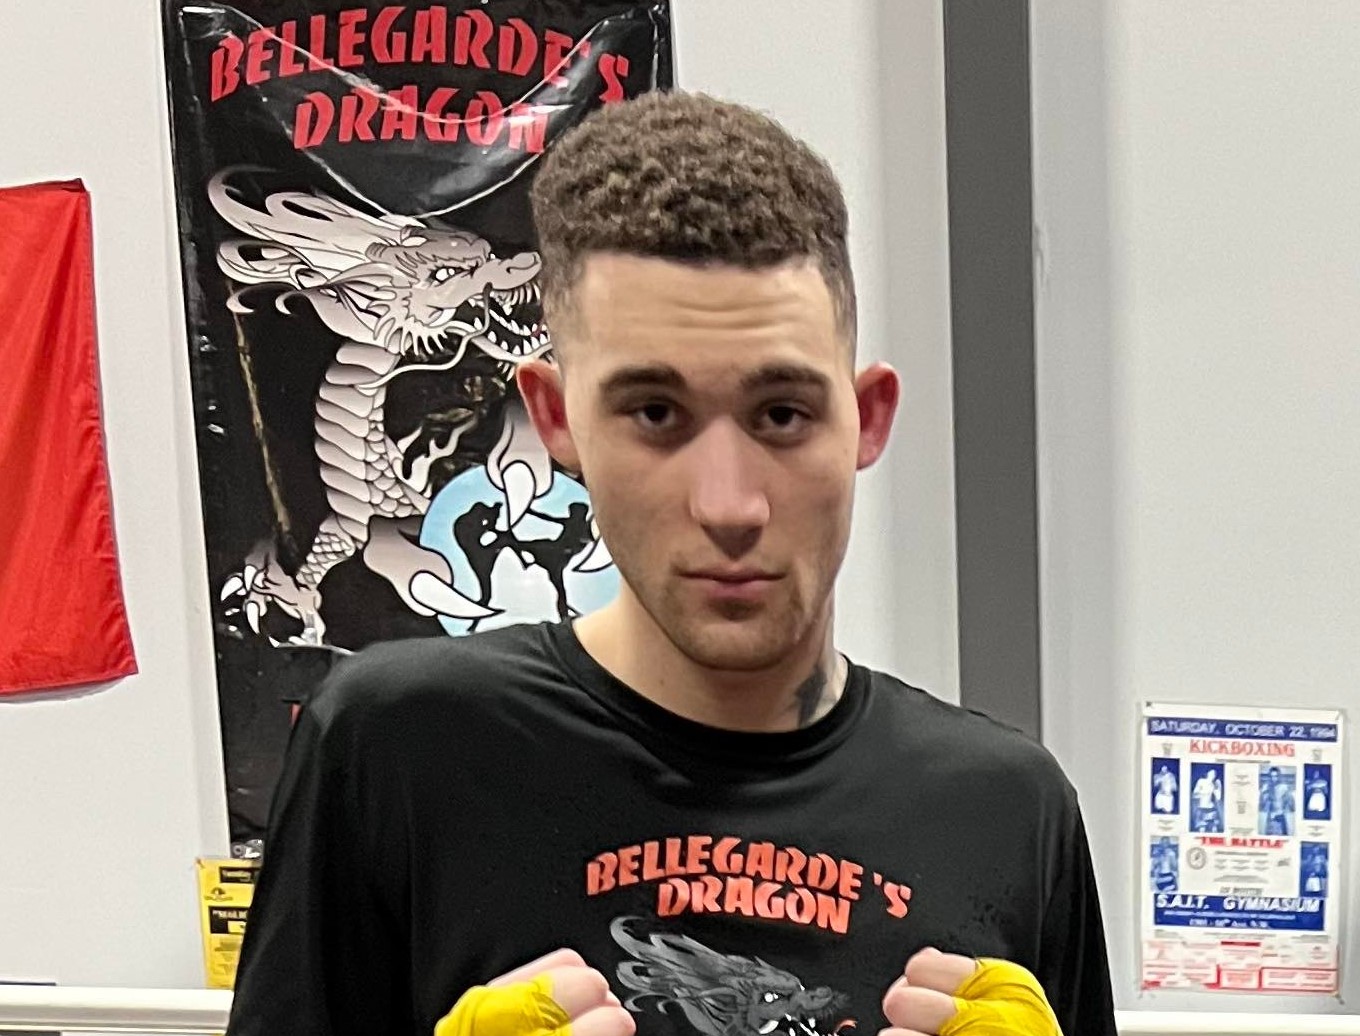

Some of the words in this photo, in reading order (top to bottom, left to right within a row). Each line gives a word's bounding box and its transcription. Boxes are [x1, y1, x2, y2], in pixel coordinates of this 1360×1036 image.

[211, 6, 629, 104] BELLEGARDE'S
[294, 85, 551, 153] DRAGON
[1189, 738, 1296, 757] KICKBOXING
[587, 836, 911, 918] BELLEGARDE'S
[657, 876, 850, 933] DRAGON
[1222, 896, 1320, 913] GYMNASIUM
